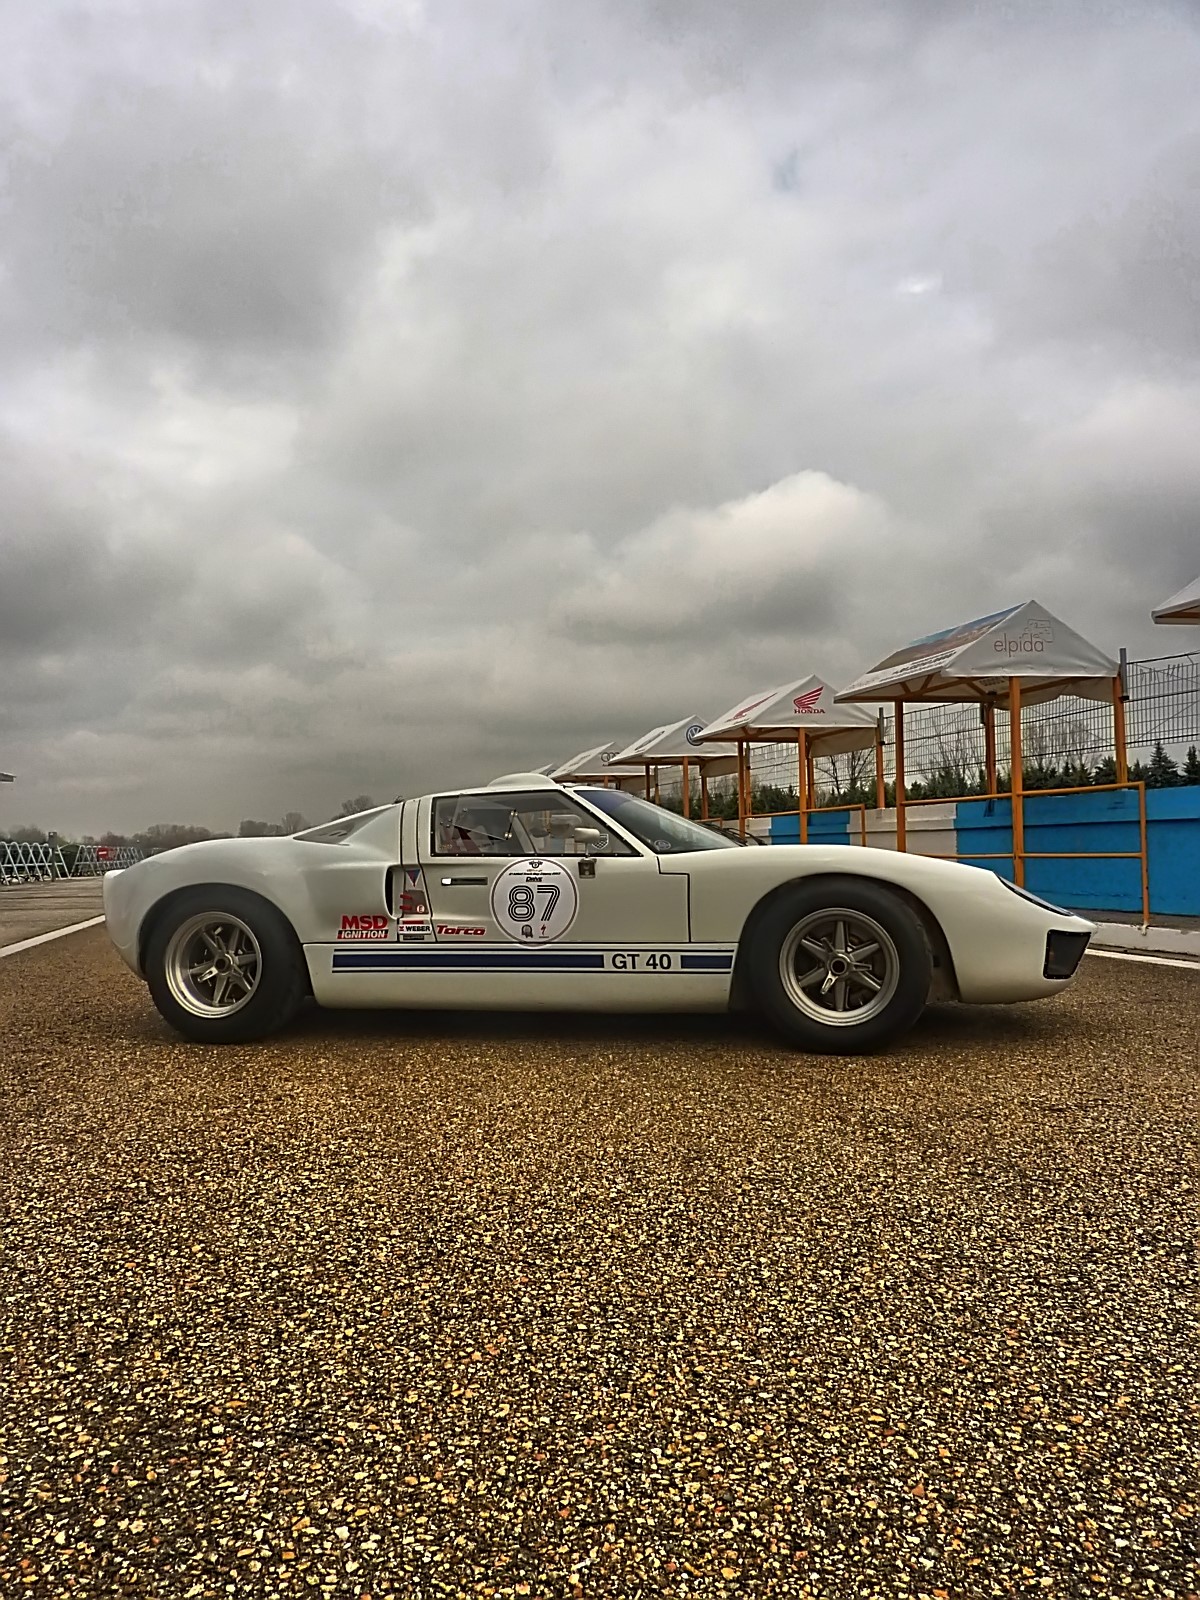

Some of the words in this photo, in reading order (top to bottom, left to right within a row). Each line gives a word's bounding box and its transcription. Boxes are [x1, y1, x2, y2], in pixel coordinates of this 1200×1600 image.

[993, 633, 1044, 657] elpida
[508, 885, 561, 922] 87
[341, 916, 388, 930] MSD
[437, 925, 486, 936] Torco
[340, 930, 387, 939] IGNITION
[612, 953, 640, 970] GT
[646, 953, 672, 970] 40
